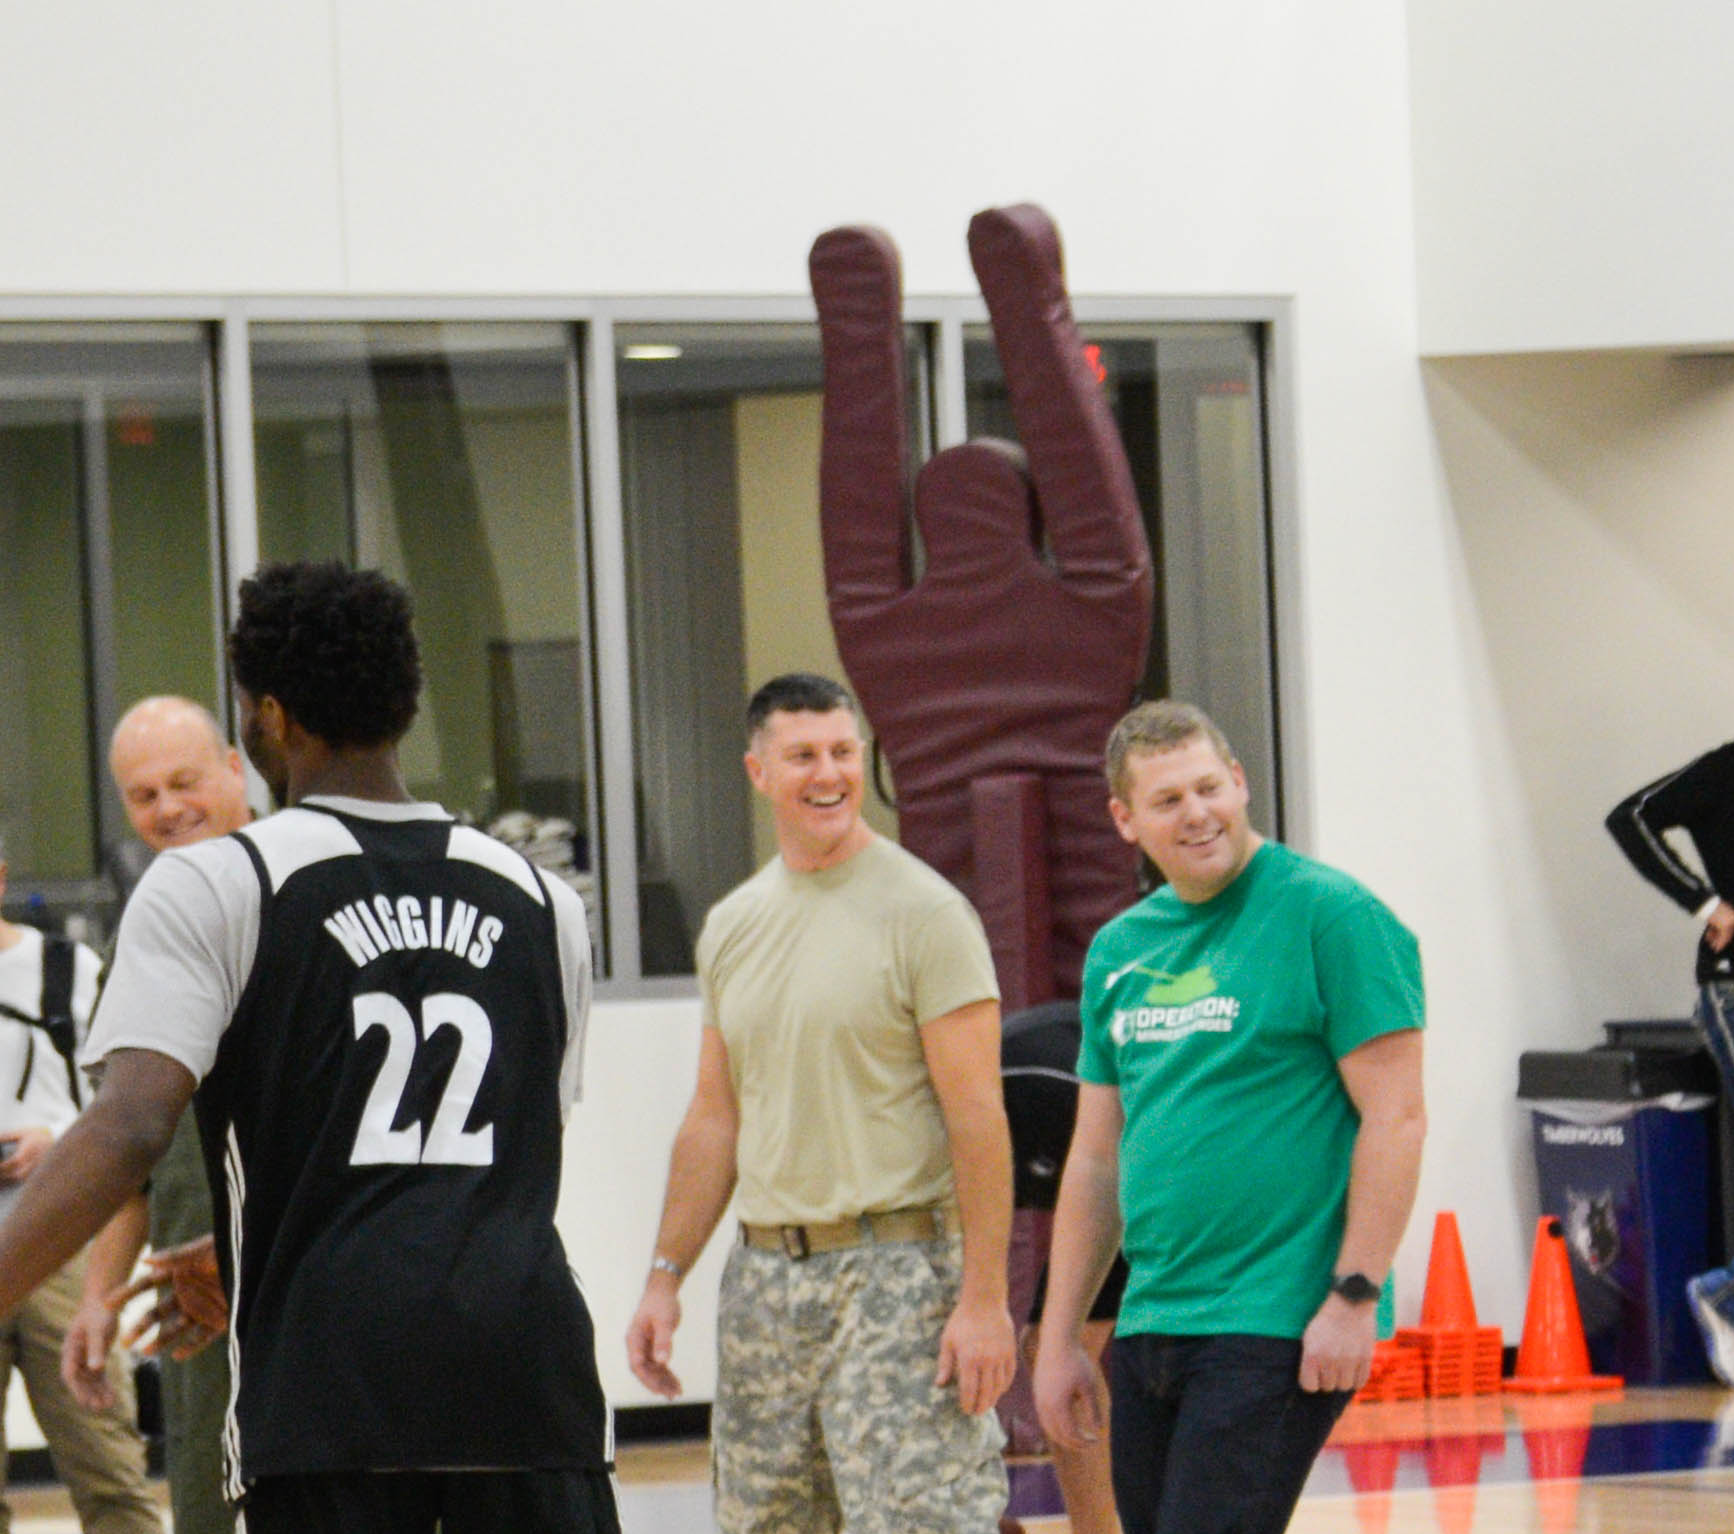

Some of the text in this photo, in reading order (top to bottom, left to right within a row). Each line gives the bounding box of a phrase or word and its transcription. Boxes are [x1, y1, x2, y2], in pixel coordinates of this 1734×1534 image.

[323, 894, 504, 968] WIGGINS
[1137, 997, 1241, 1028] OPEON:
[349, 991, 494, 1166] 22
